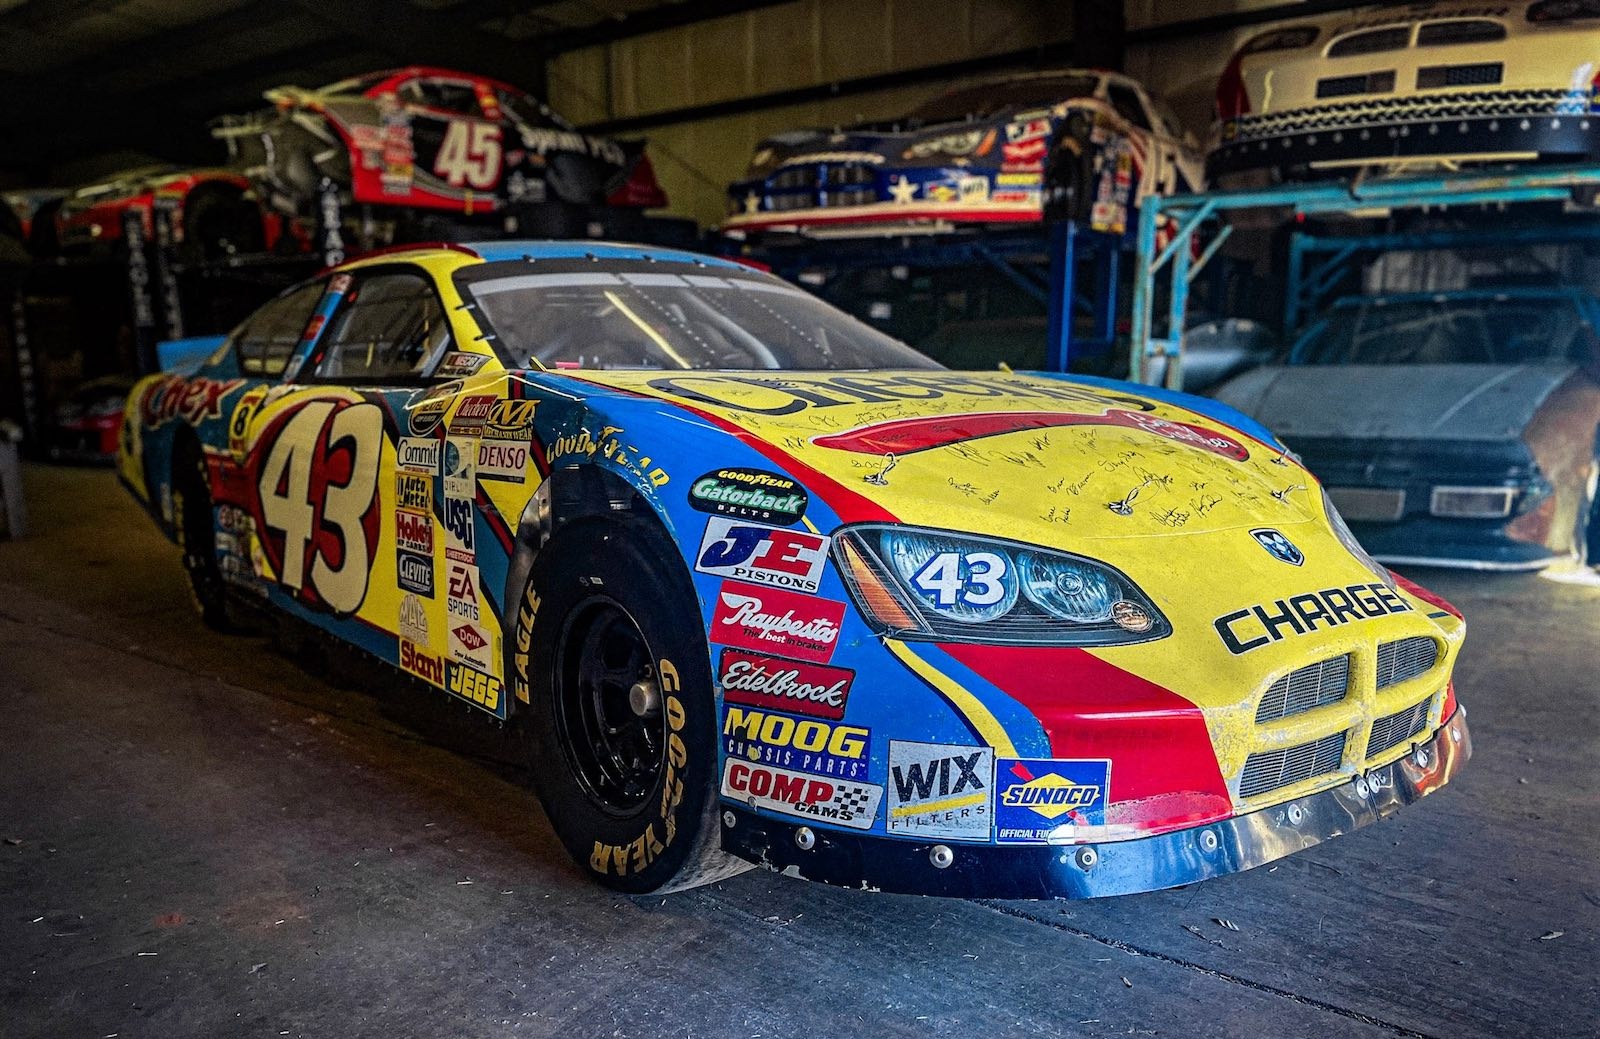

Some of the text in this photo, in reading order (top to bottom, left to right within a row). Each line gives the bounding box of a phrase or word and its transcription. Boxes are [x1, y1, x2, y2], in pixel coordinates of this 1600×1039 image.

[432, 119, 506, 191] 45
[397, 439, 438, 466] Commit
[479, 446, 525, 469] DENSO
[405, 477, 426, 492] Auto
[692, 478, 803, 514] Gatorback
[718, 470, 794, 489] GOODYEAR
[258, 400, 384, 616] 43
[445, 498, 473, 549] USG
[718, 505, 770, 518] BELTS
[397, 514, 432, 553] Holley
[700, 526, 824, 577] JE
[449, 566, 478, 604] EA
[733, 567, 816, 591] PISTONS
[911, 552, 1007, 608] 43
[399, 594, 428, 632] MAC
[448, 598, 479, 621] SPORTS
[721, 592, 838, 643] Raybestos
[515, 580, 541, 705] EAGLE
[743, 628, 760, 639] The
[765, 633, 787, 644] best
[796, 640, 828, 652] brakes
[401, 640, 443, 686] Stant
[450, 665, 499, 710] JEGS
[721, 661, 846, 707] Edelbrock
[723, 707, 869, 759] MOOG
[729, 764, 834, 806] COMP
[803, 755, 859, 777] PARTS
[892, 751, 985, 803] WIX
[795, 801, 855, 821] CAMS
[1006, 786, 1097, 805] SUNOCO
[891, 806, 986, 830] FILTERS
[1000, 828, 1034, 838] OFFICIAL
